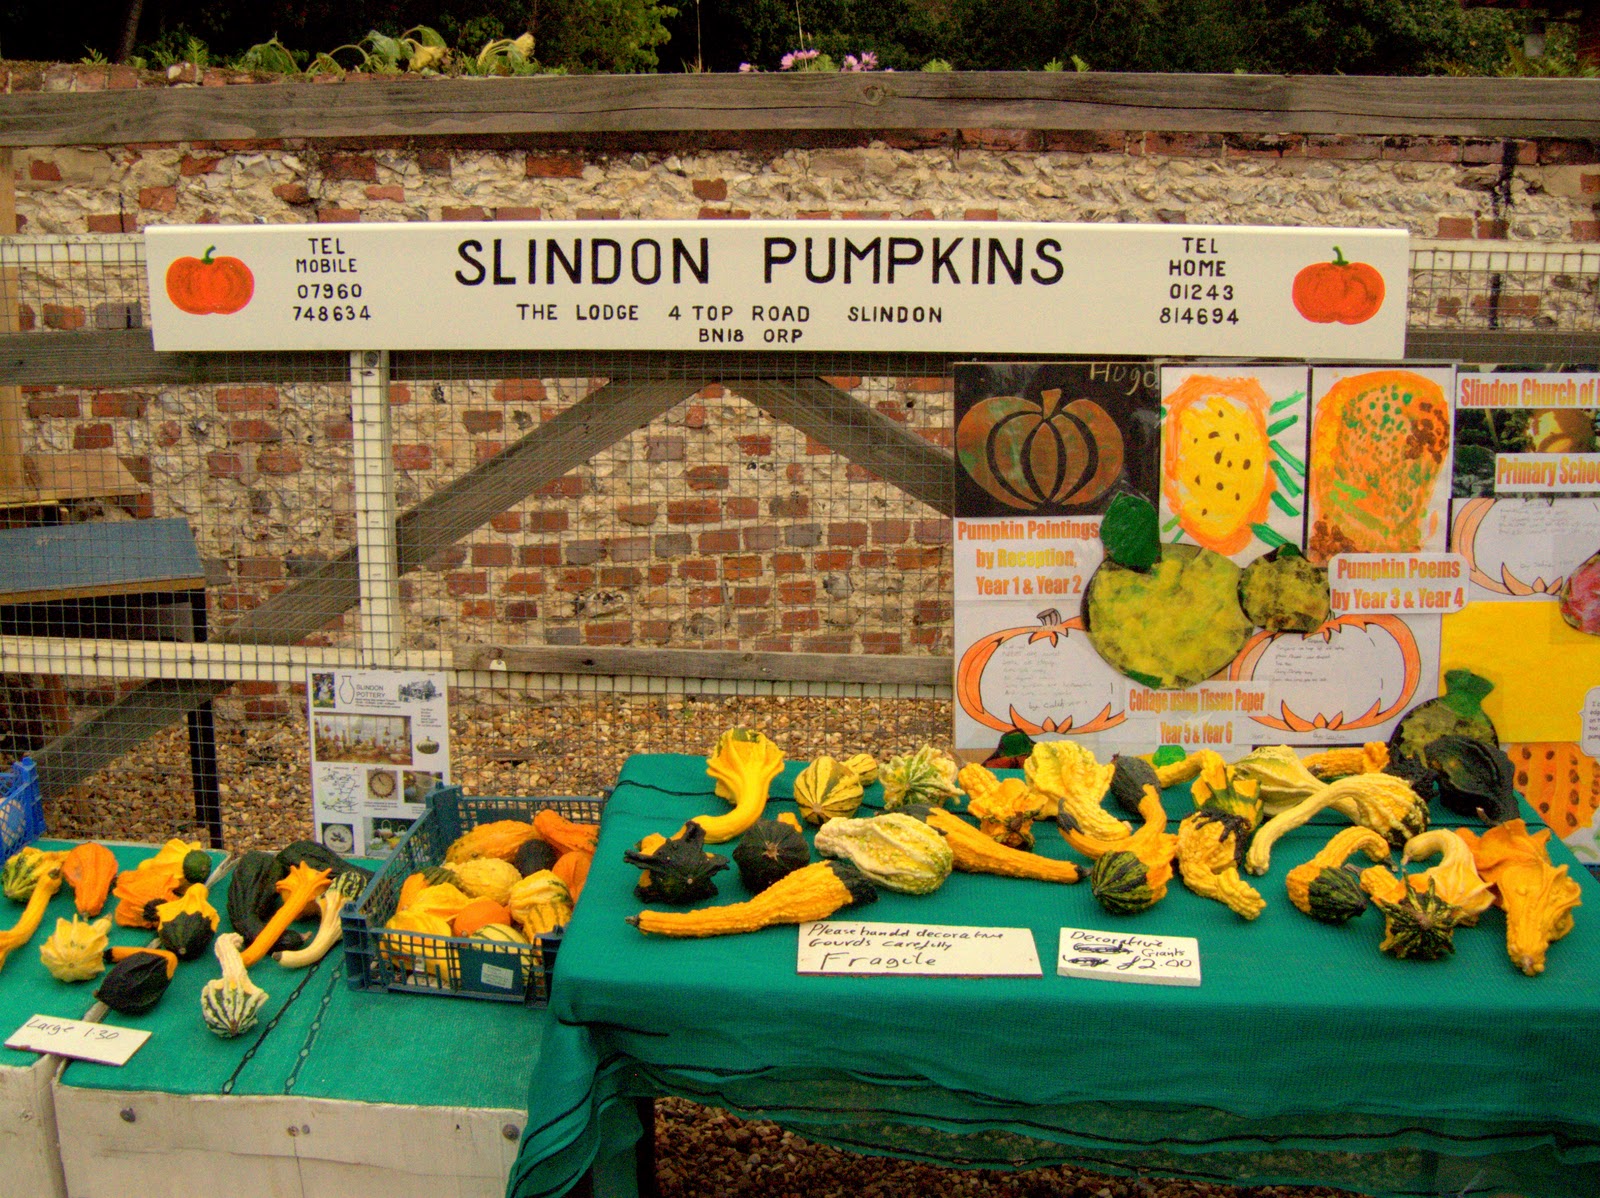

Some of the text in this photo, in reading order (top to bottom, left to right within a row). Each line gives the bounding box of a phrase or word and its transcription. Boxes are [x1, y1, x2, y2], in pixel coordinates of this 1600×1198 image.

[308, 237, 346, 254] TEL
[1181, 237, 1219, 254] TEL
[296, 258, 358, 274] MOBILE
[455, 236, 1063, 287] SLINDON PUMPKINS
[1169, 259, 1226, 277] HOME
[297, 283, 362, 300] 07960
[1169, 284, 1234, 301] 01243
[292, 305, 372, 322] 748634
[516, 304, 942, 323] THE LODGE 4 TOP ROAD SLINDON
[1159, 307, 1240, 325] 814694
[698, 328, 745, 343] BN18
[1461, 378, 1519, 407] Slindon
[1521, 378, 1577, 407] Church
[1579, 378, 1595, 406] of
[1496, 457, 1558, 487] Primary
[957, 520, 1100, 542] Pumpkin Paintings
[976, 548, 995, 570] by
[1337, 557, 1461, 581] Pumpkin Poems
[976, 574, 1082, 596] Year 1 & Year 2
[1331, 586, 1464, 611] by Year 3 & Year 4
[1128, 688, 1265, 714] Collage using Tissue Paper
[1161, 721, 1233, 744] Year 5 & Year 6
[808, 923, 856, 937] Please
[1070, 931, 1163, 948] Decorative
[820, 951, 937, 971] Fragile
[1141, 947, 1186, 958] Giants
[1116, 955, 1193, 971] £2.00
[26, 1018, 75, 1036] Large
